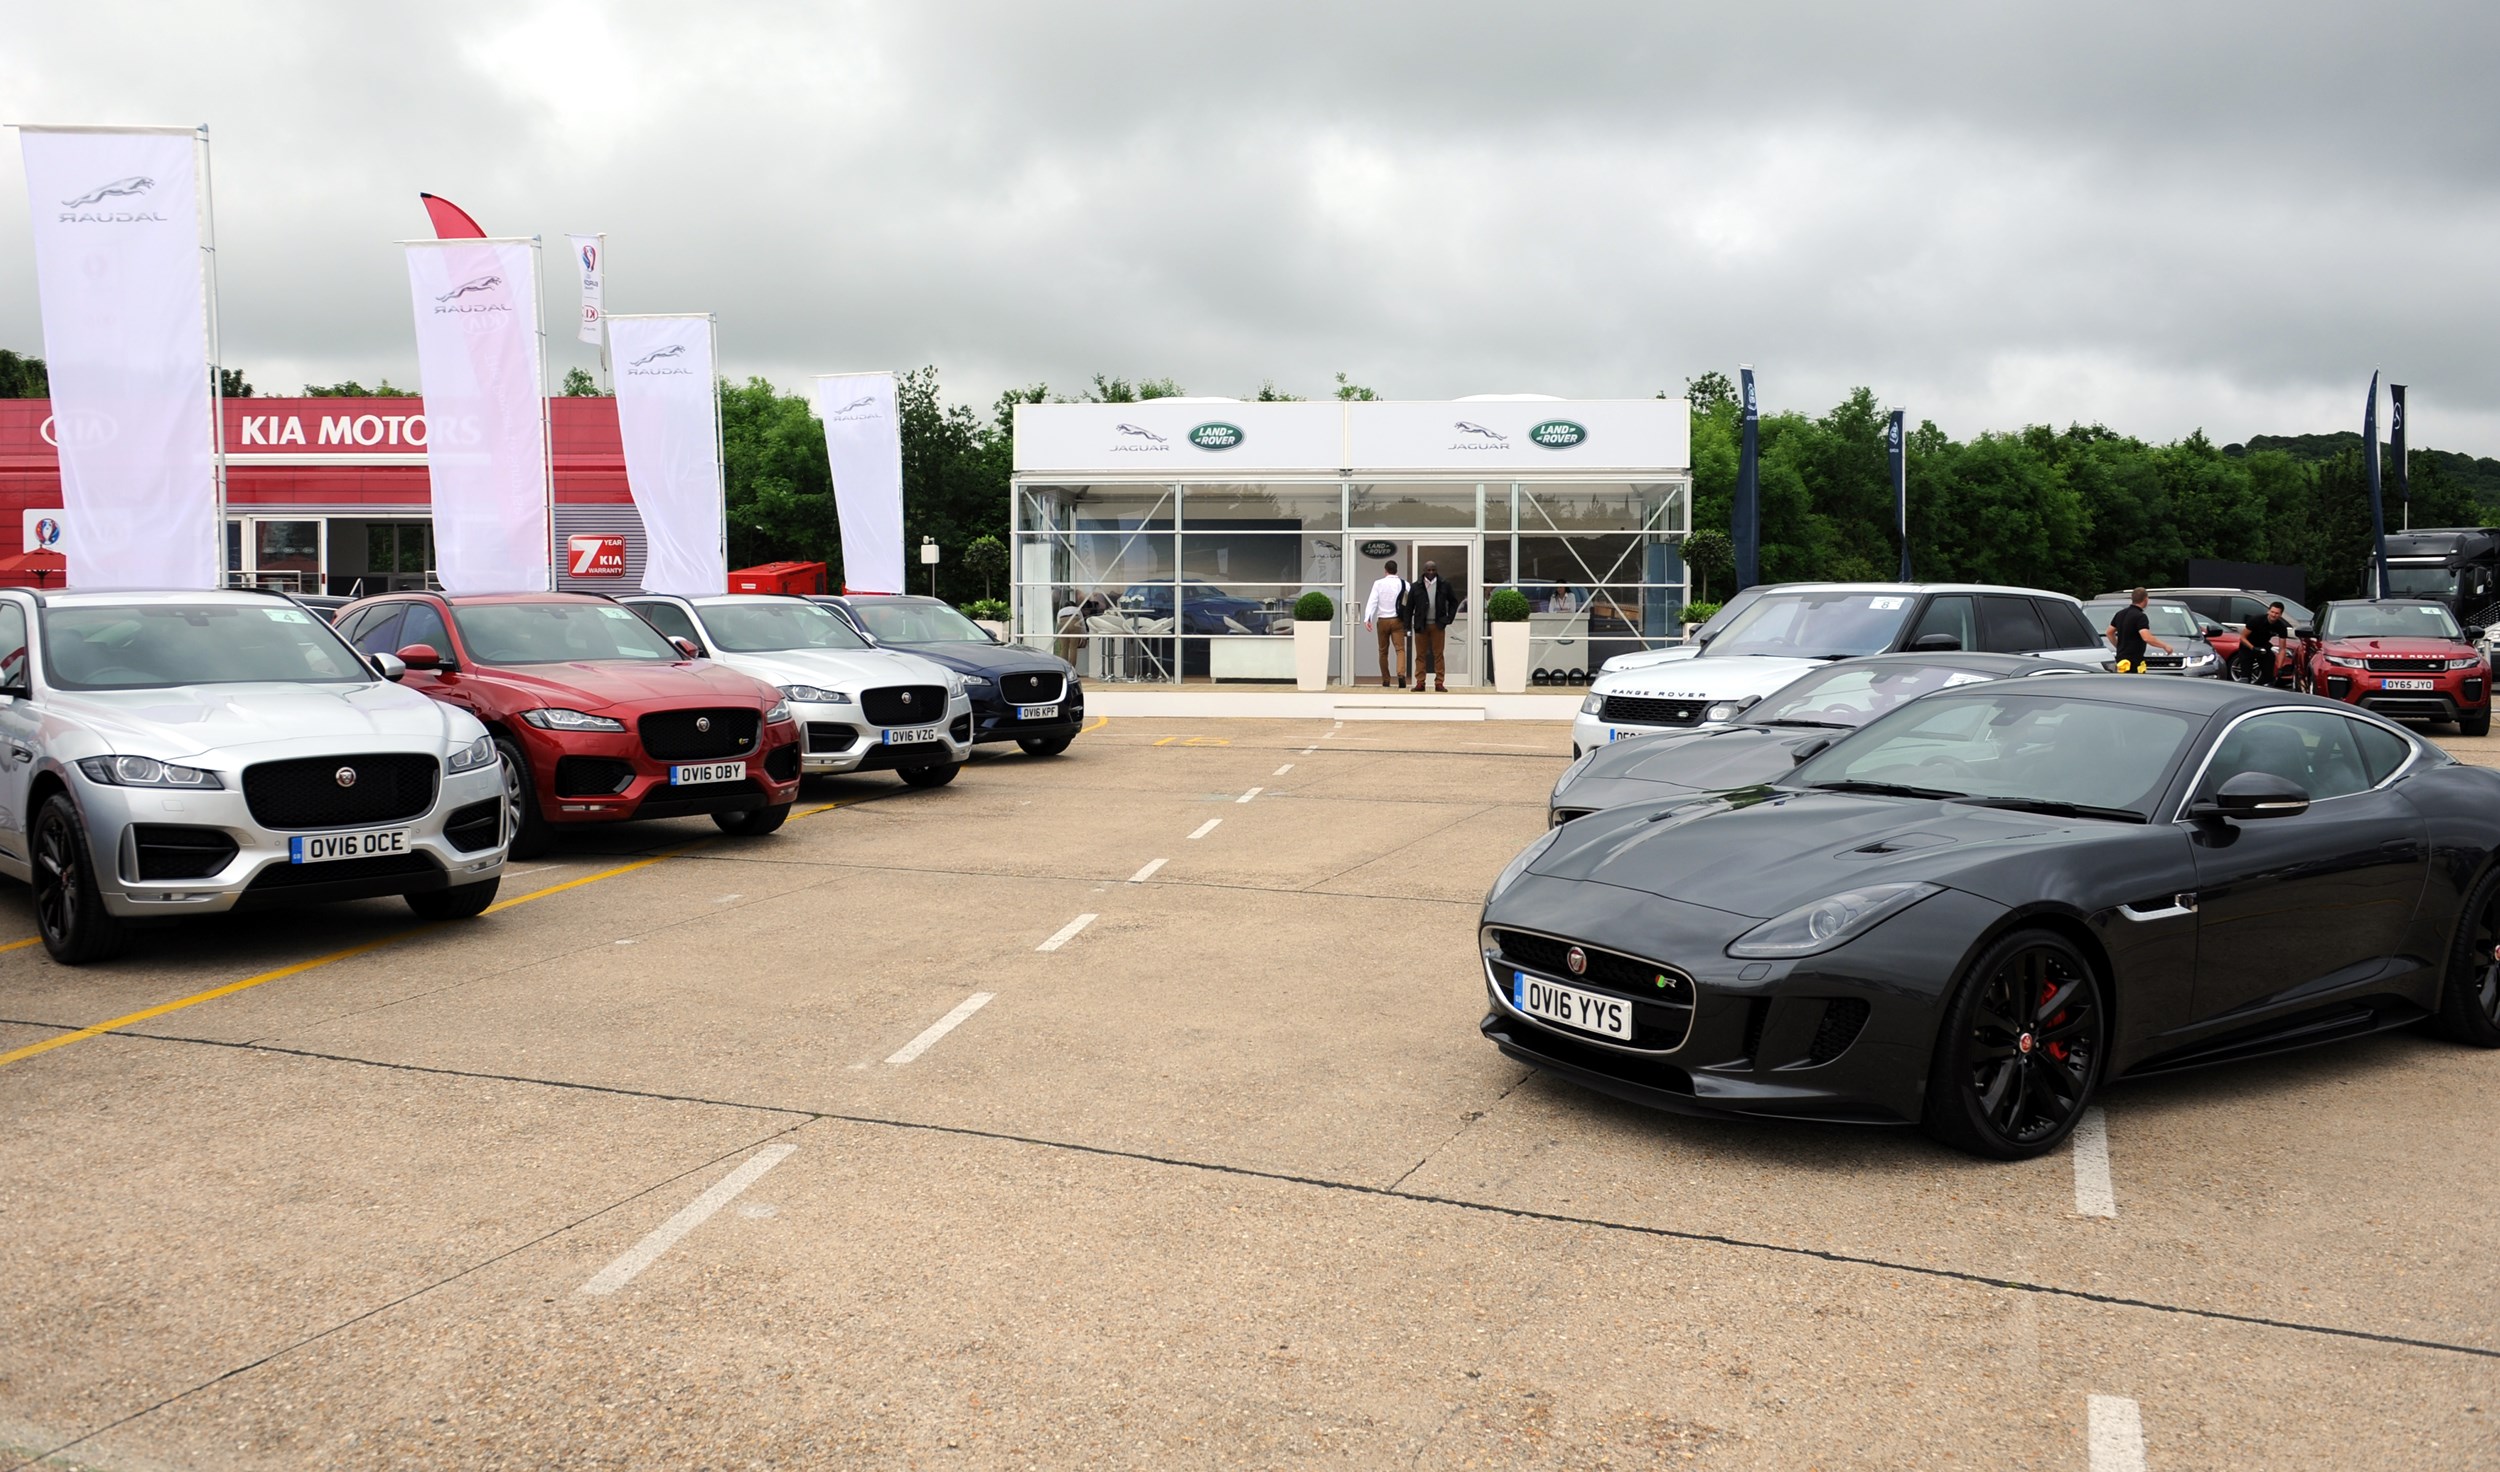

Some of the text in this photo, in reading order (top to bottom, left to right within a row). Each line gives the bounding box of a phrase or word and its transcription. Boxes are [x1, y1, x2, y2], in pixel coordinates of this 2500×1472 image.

[241, 415, 306, 445] KIA
[1198, 427, 1227, 436] LAND
[1540, 425, 1570, 434] LAND
[1200, 436, 1236, 445] ROVER
[1542, 434, 1578, 443] ROVER
[1109, 444, 1170, 452] JAGUAR
[571, 539, 604, 574] 7
[600, 555, 622, 566] KIA
[1881, 601, 1890, 609] 8
[2387, 680, 2432, 689] OY65 JYO
[1023, 706, 1056, 718] OV16 KPF
[892, 729, 935, 742] OV16 VZG
[682, 764, 741, 782] OV16 OBY
[311, 832, 403, 858] OV16 OCE
[1529, 983, 1622, 1033] OV16 YYS
